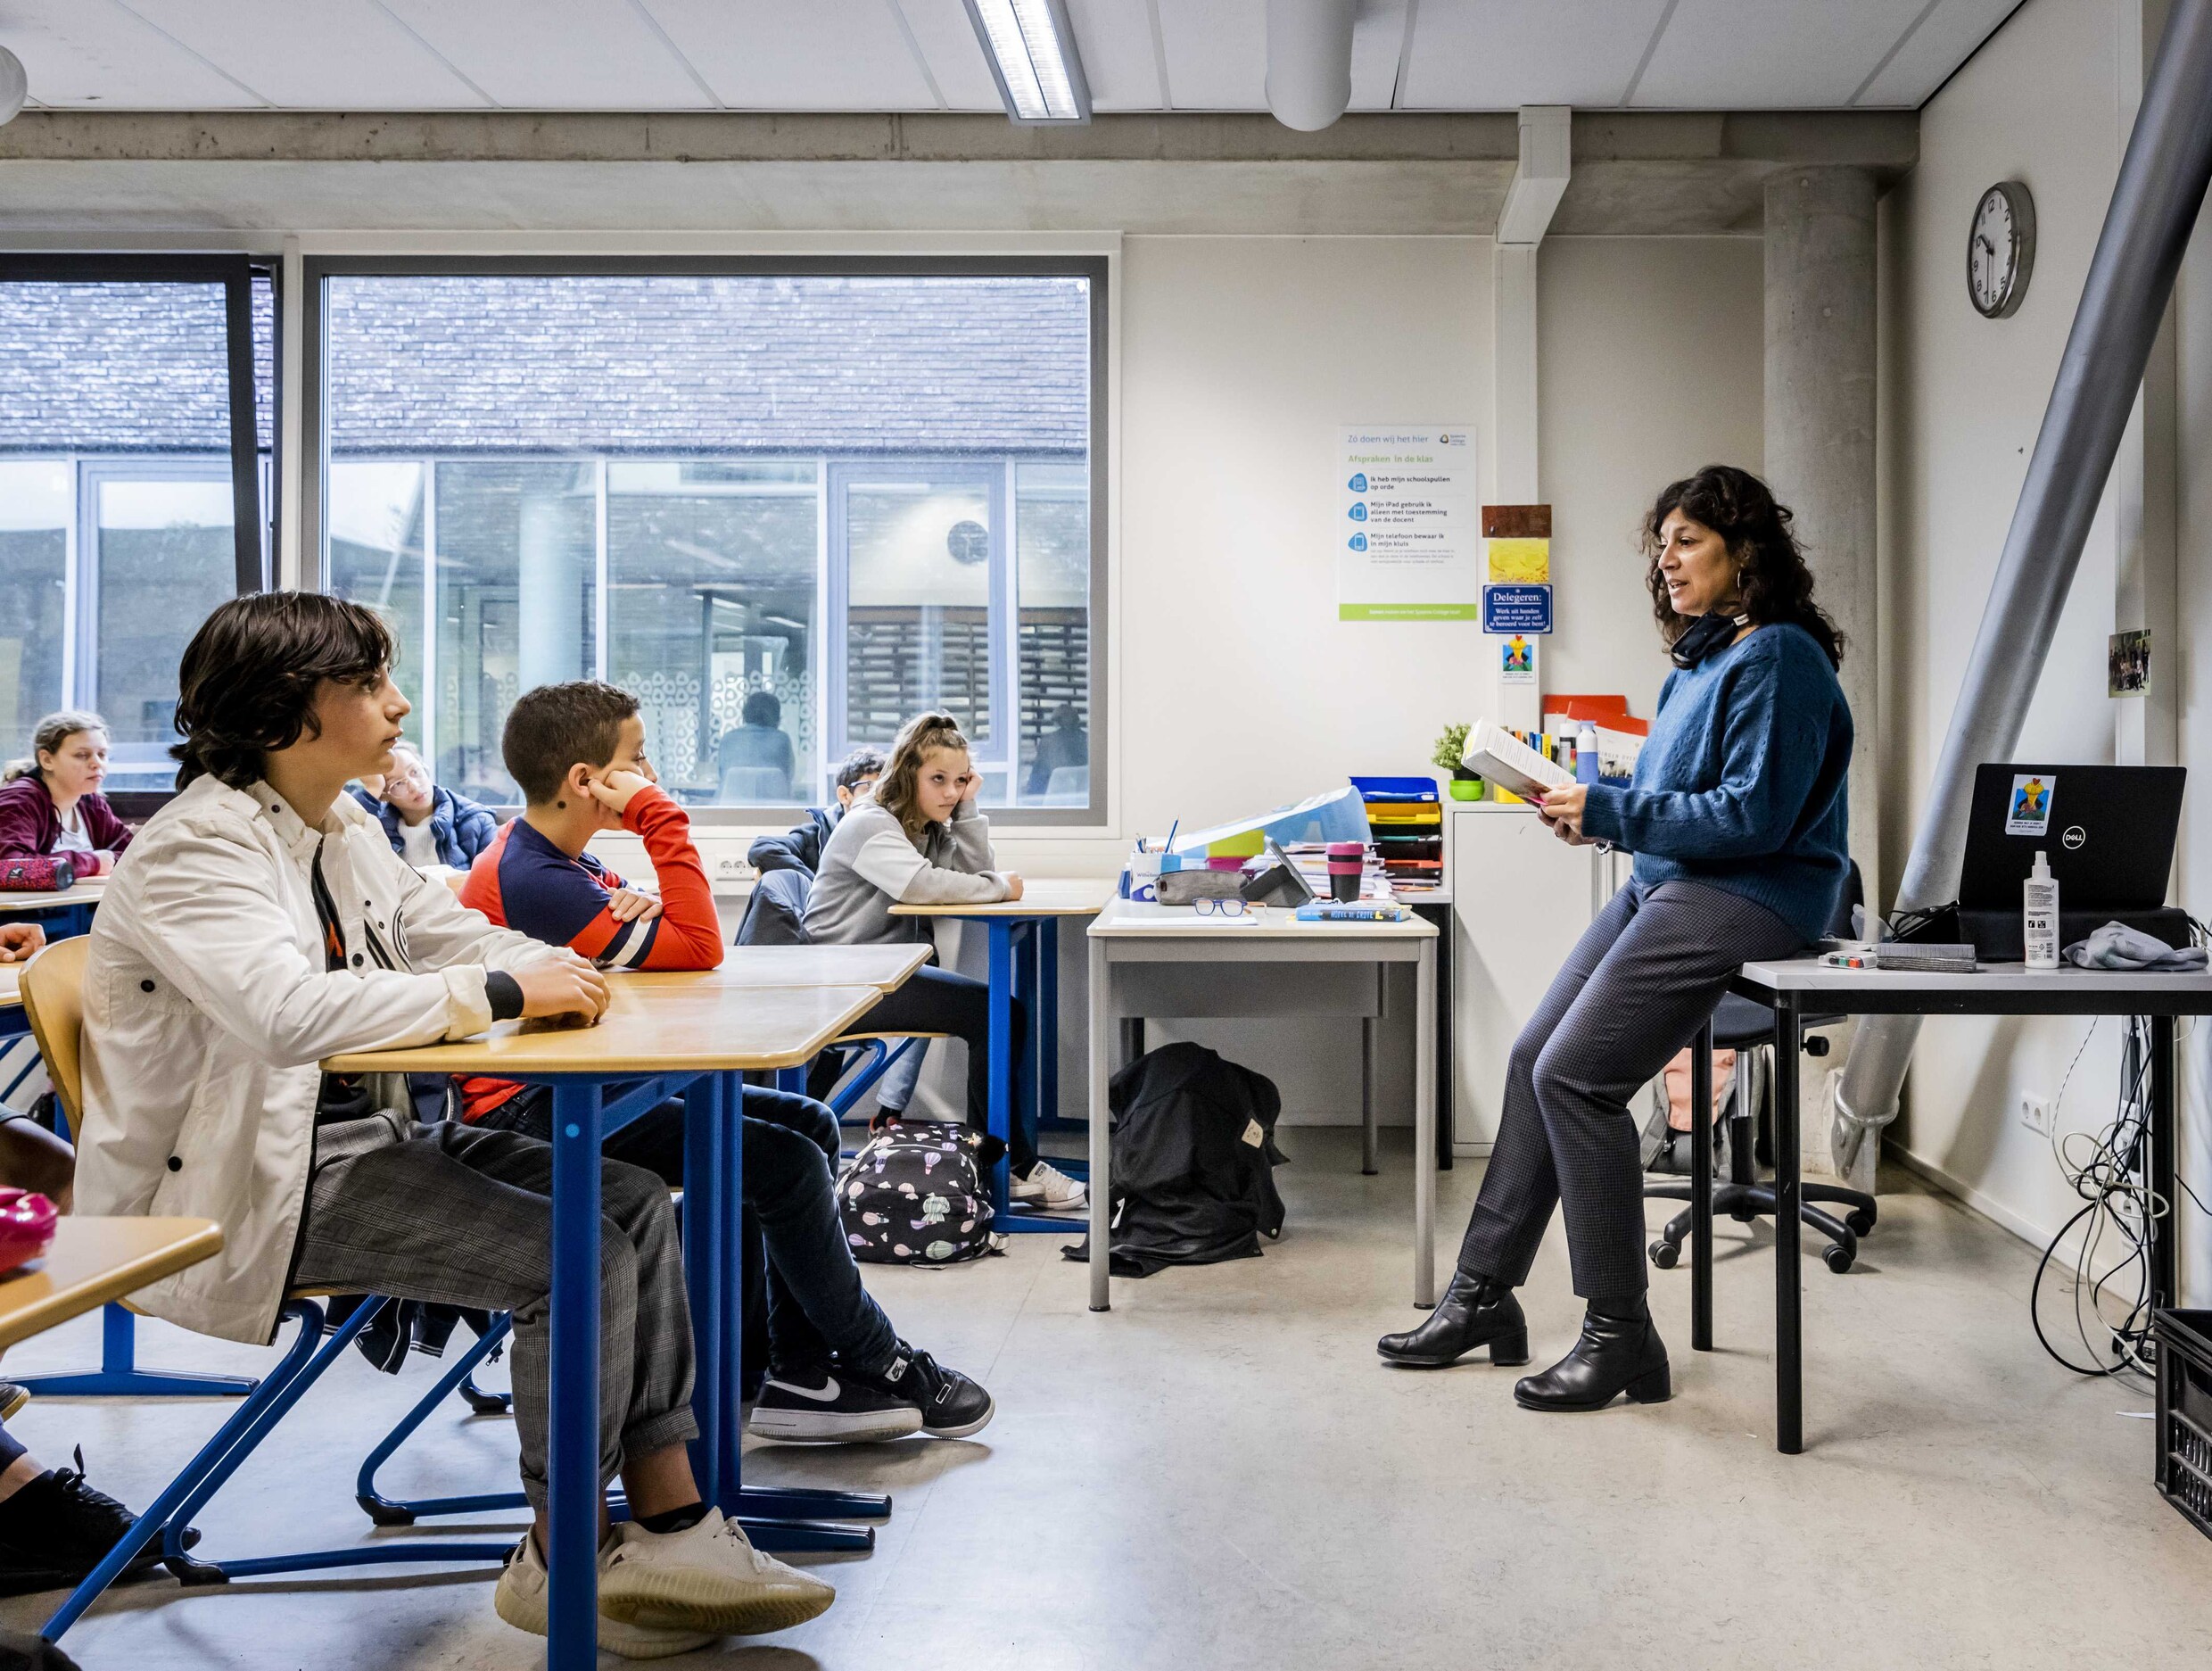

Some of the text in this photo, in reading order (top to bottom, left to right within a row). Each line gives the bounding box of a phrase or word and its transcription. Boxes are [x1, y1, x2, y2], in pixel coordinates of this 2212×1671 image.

[1988, 198, 1995, 214] 12
[1981, 212, 1986, 227] 11
[2004, 208, 2010, 223] 2
[1974, 260, 1979, 273] 9
[1977, 279, 1982, 293] 8
[2000, 276, 2006, 291] 5
[1992, 290, 1997, 302] 6
[1360, 434, 1381, 443] doen
[1382, 435, 1395, 445] wij
[1397, 434, 1410, 443] het
[1412, 434, 1429, 443] hier
[1348, 455, 1391, 464] Afspraken
[1404, 455, 1415, 463] de
[1416, 455, 1433, 463] klas
[1400, 501, 1425, 509] gebruik
[1493, 592, 1542, 603] Delegeren:
[1375, 911, 1383, 920] L
